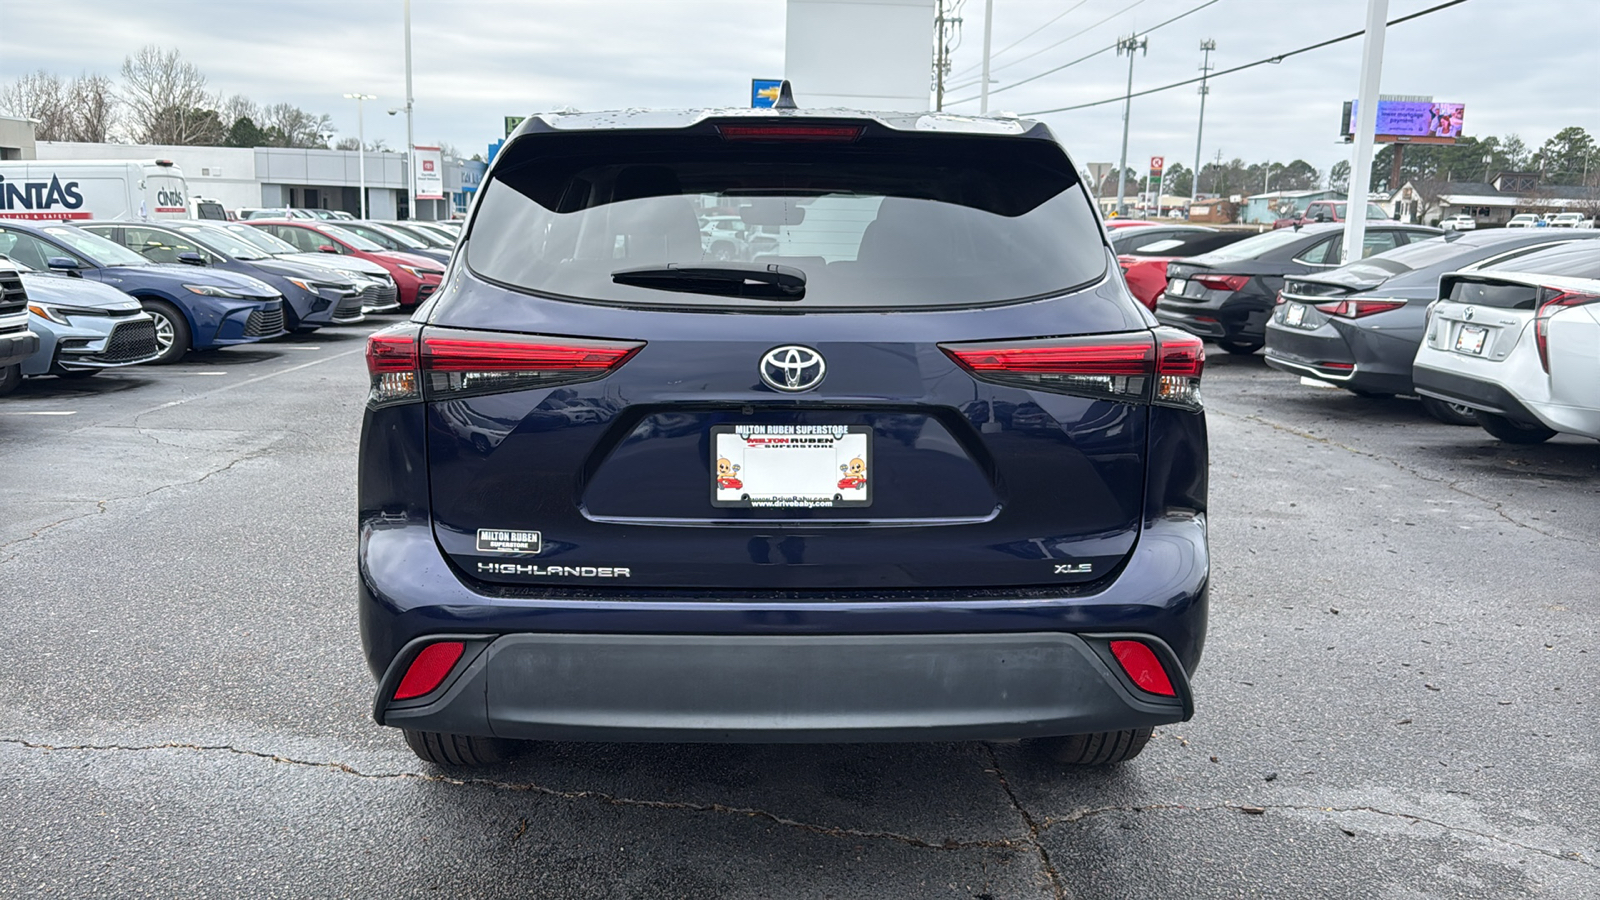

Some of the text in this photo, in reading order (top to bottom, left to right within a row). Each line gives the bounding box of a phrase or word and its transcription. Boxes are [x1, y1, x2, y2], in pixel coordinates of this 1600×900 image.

[0, 173, 84, 210] INTAS
[735, 425, 848, 434] MILTON RUBEN SUPERSTORE
[480, 531, 538, 543] MILTON RUBEN
[490, 541, 529, 549] SUPERSTORE
[477, 562, 631, 578] HIGHLANDER
